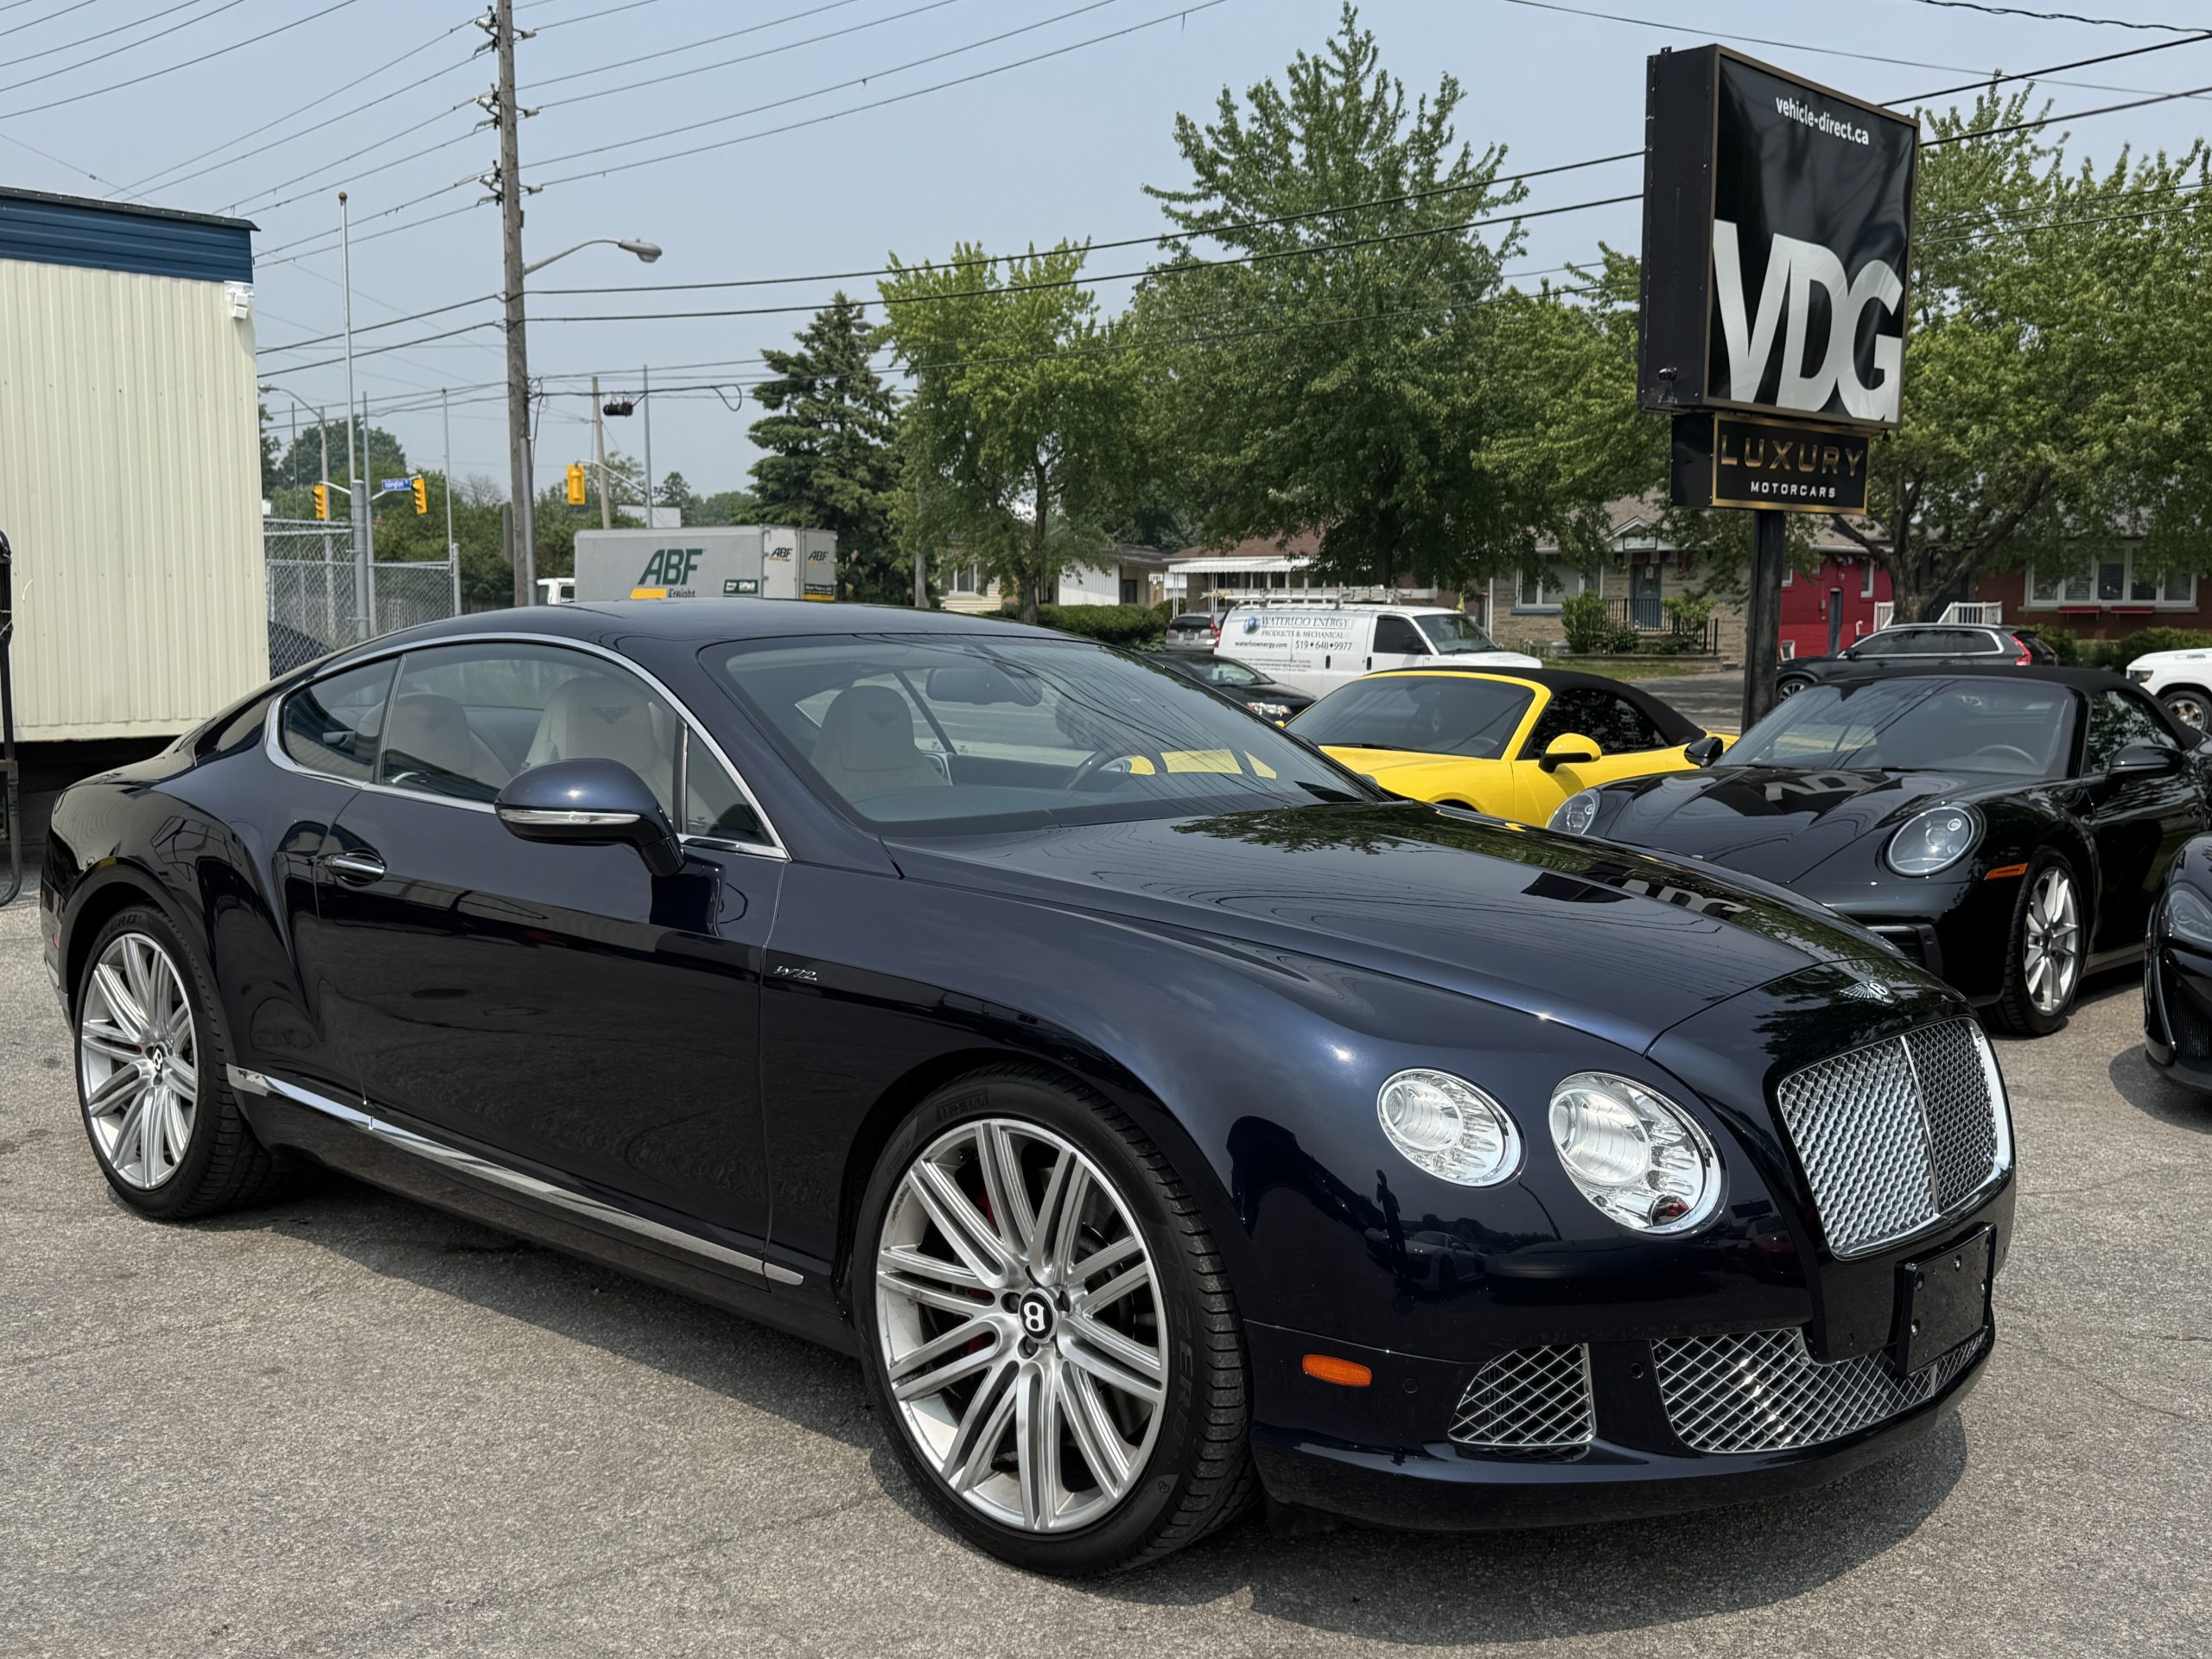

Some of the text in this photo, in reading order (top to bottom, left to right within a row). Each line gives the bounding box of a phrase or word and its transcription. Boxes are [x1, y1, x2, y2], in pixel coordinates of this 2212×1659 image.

[1776, 98, 1869, 145] vehicle-direct.ca
[1713, 219, 1903, 423] VDG
[1721, 435, 1864, 476] LUXURY
[1751, 481, 1836, 498] MOTORCARS
[638, 548, 703, 585] ABF
[772, 547, 792, 557] ABF
[809, 550, 828, 561] ABF
[1262, 616, 1349, 627] WATERLOO ENERGY
[1023, 1301, 1046, 1332] B
